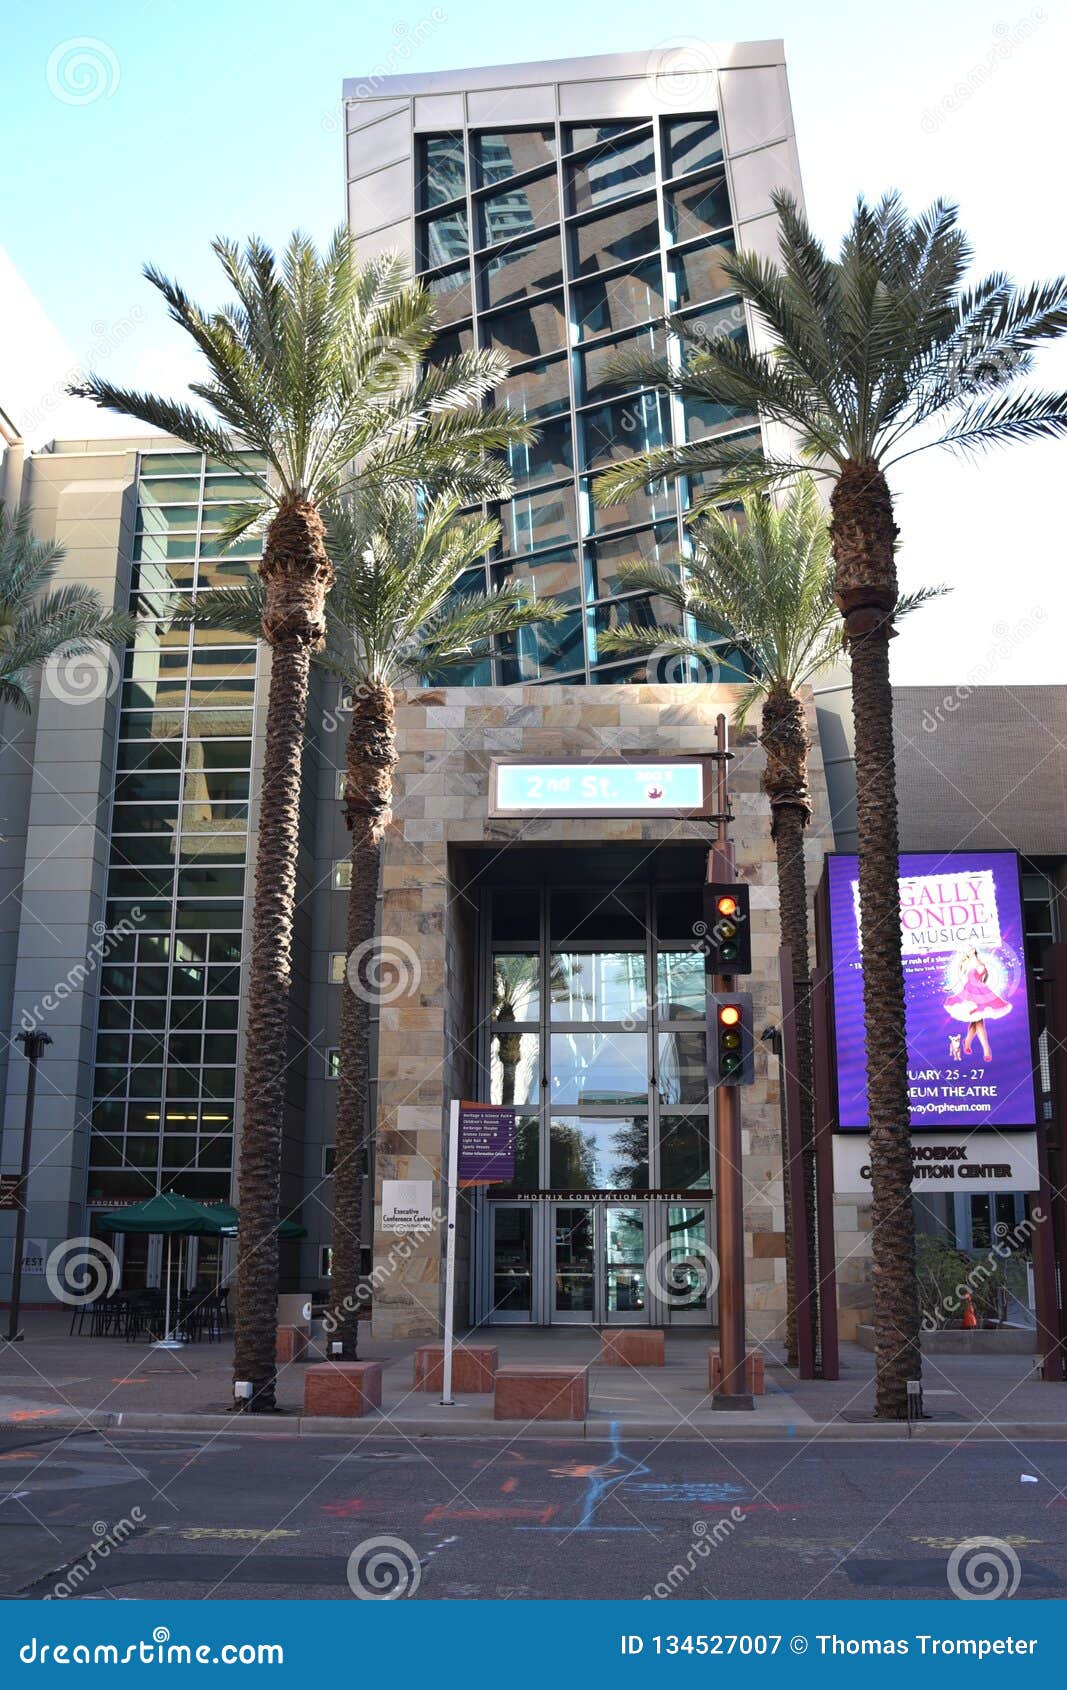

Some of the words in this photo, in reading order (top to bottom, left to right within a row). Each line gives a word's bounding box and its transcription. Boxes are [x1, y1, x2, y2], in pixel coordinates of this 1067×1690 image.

[527, 775, 571, 799] 2nd
[580, 775, 619, 799] St.
[898, 881, 983, 906] GALLY
[901, 903, 989, 930] ONDE
[911, 926, 991, 945] MUSICAL
[908, 1070, 942, 1080] UARY
[945, 1070, 959, 1080] 25
[970, 1069, 985, 1080] 27
[941, 1086, 997, 1097] THEATRE
[908, 1103, 991, 1114] wayOrpheum.com
[910, 1146, 968, 1160] HOENIX
[860, 1164, 955, 1179] CNTION
[957, 1164, 1013, 1178] CENTER
[517, 1193, 563, 1201] PHOENIX
